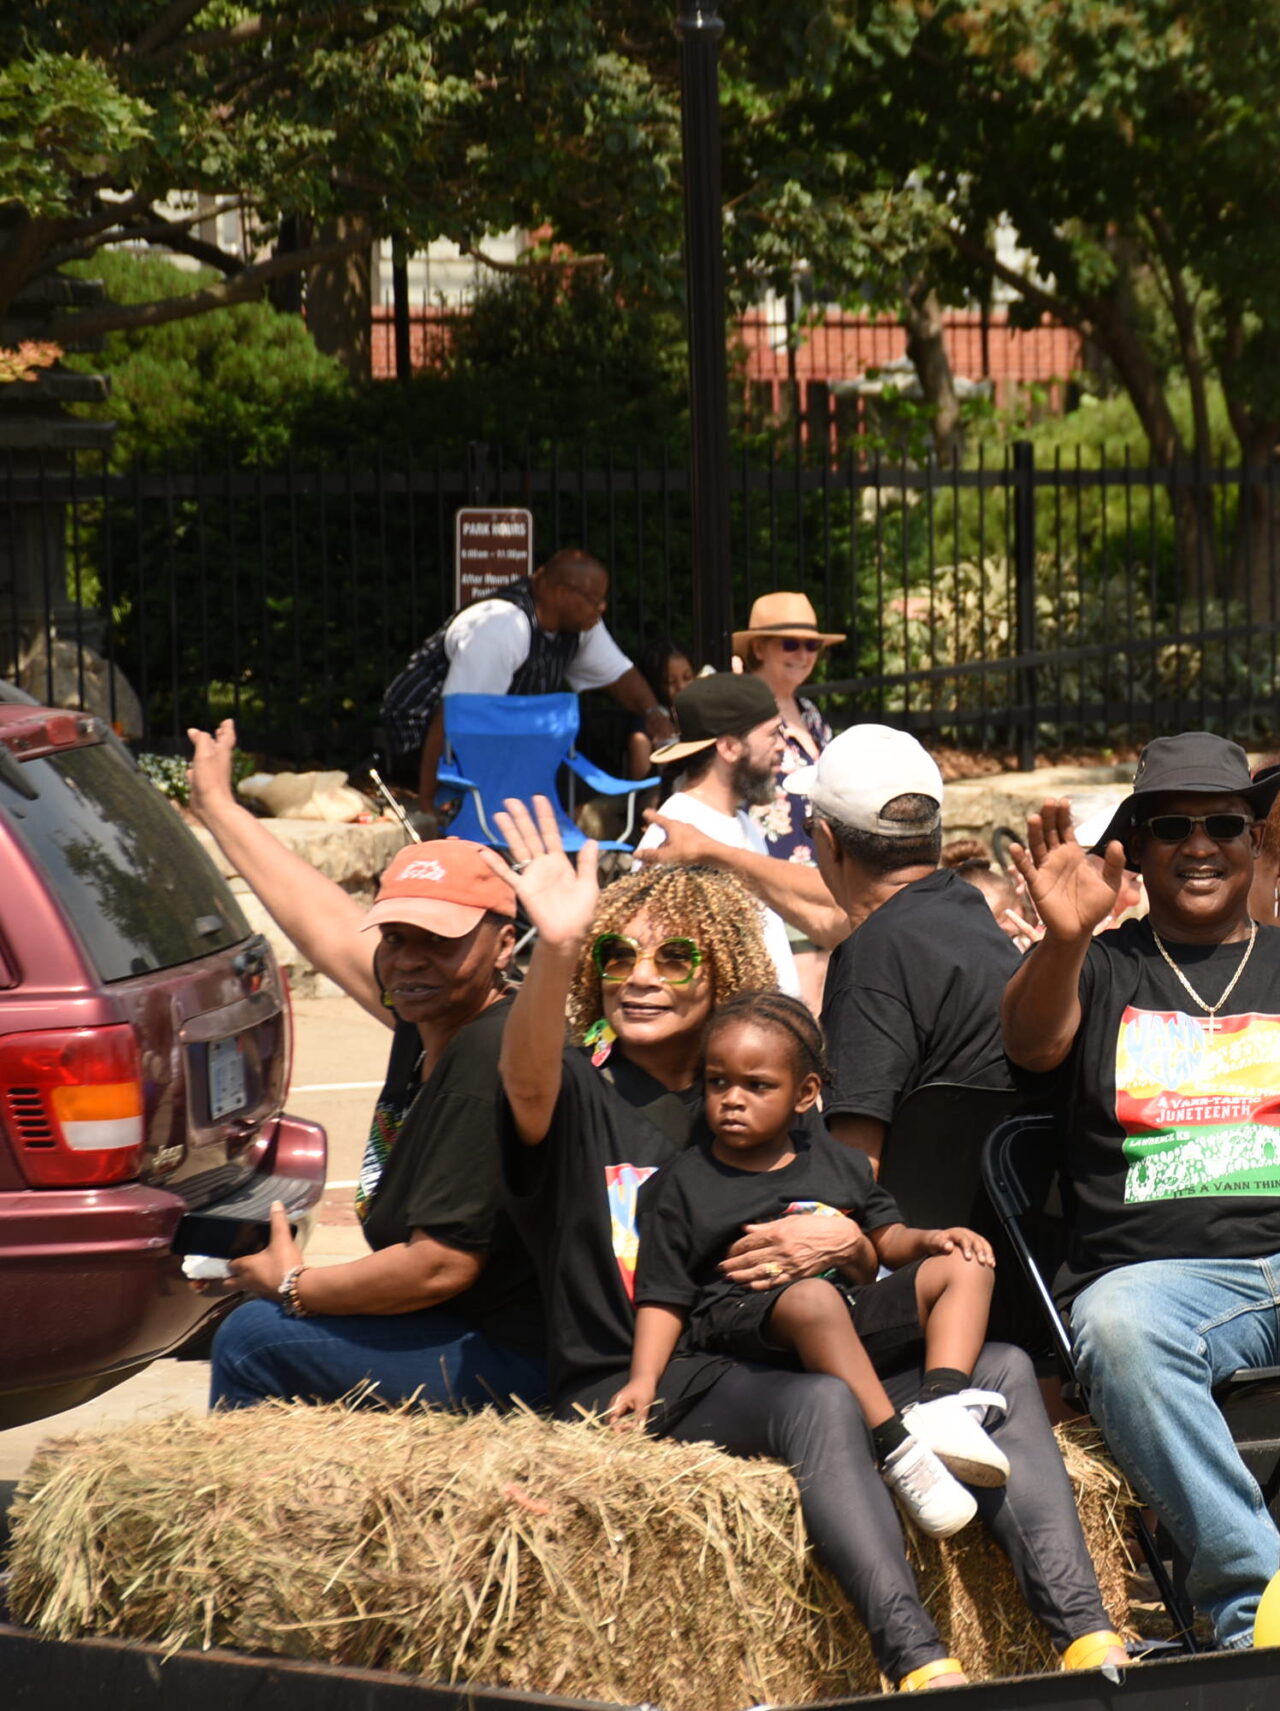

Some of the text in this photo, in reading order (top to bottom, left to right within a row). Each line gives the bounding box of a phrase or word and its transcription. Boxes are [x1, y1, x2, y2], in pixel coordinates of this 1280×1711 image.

[463, 522, 527, 537] PARK HOURS
[1158, 1095, 1262, 1109] A VANN-TASTIC
[1155, 1105, 1251, 1123] JUNETEENTH
[1200, 1184, 1209, 1193] A
[1214, 1181, 1251, 1192] VANN
